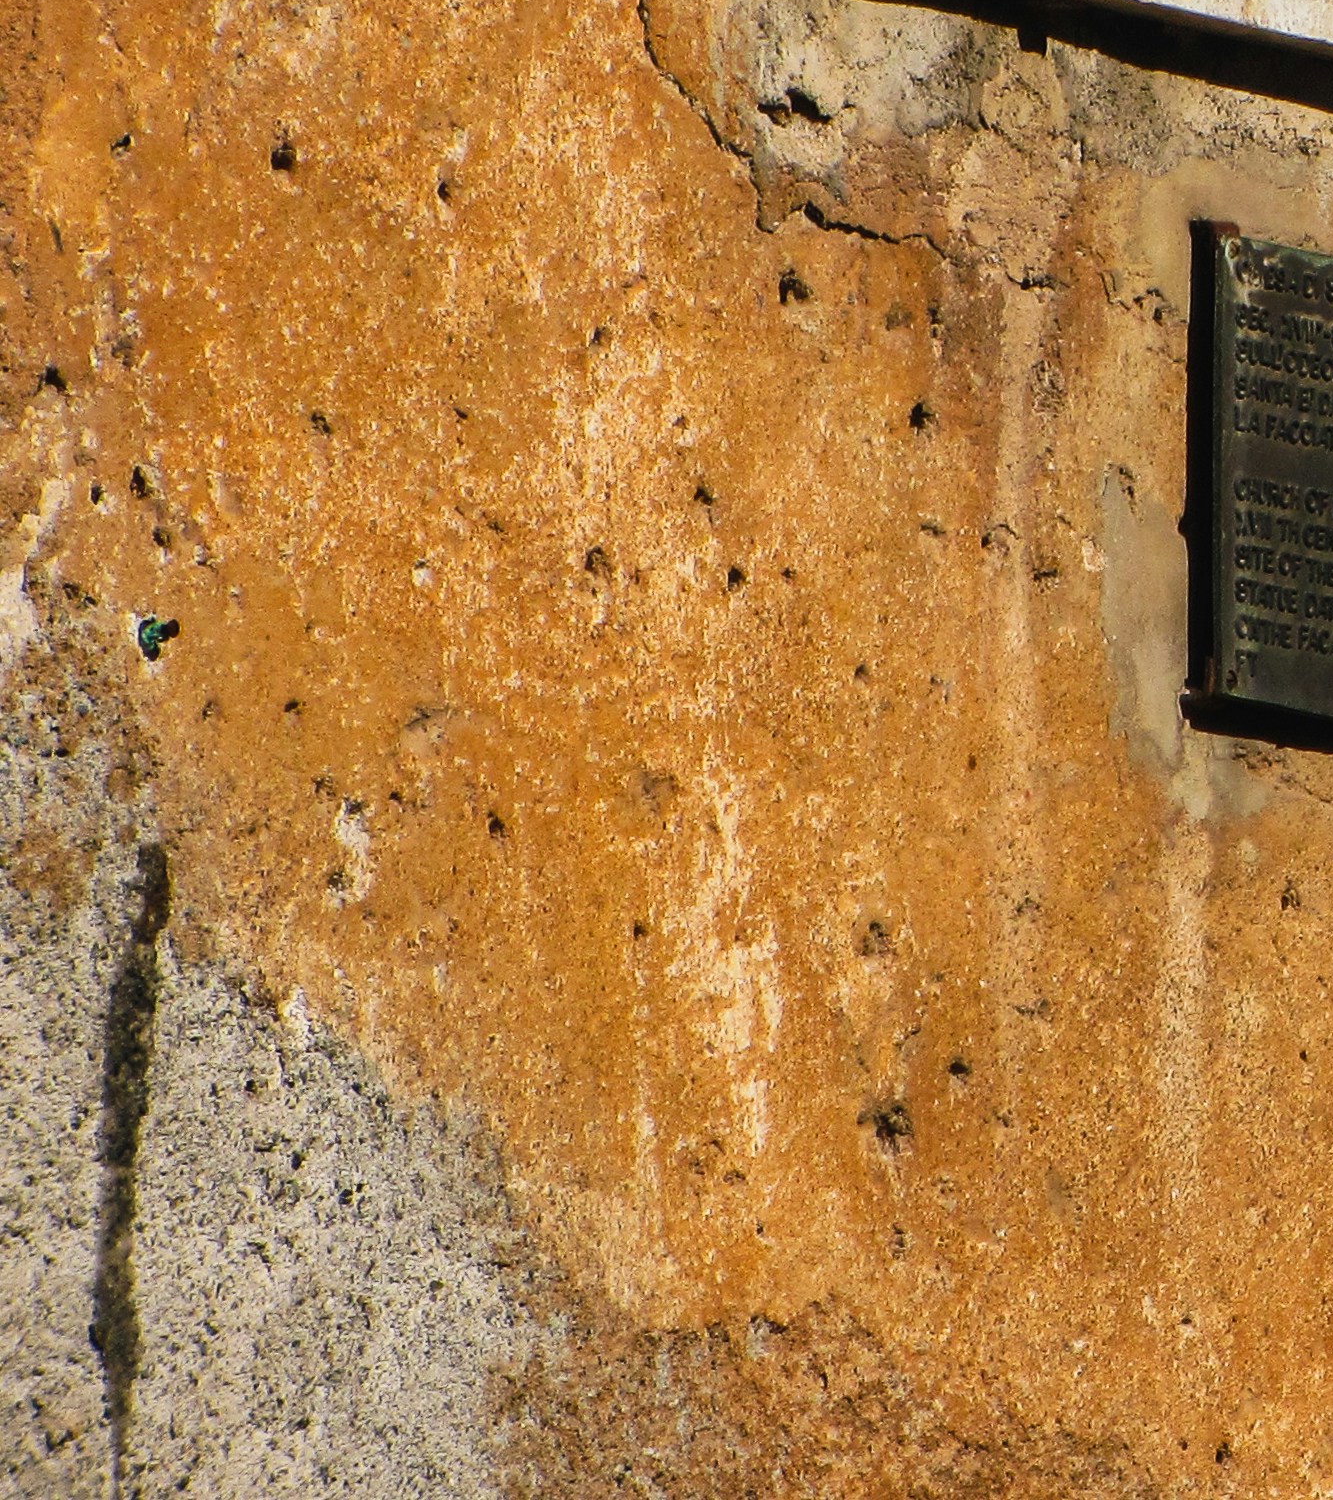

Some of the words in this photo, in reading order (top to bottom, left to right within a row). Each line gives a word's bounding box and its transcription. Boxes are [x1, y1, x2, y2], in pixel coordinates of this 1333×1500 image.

[1235, 373, 1293, 408] SANTA
[1234, 405, 1260, 435] LA
[1234, 478, 1299, 510] CHURCH
[1303, 486, 1330, 516] OF
[1235, 544, 1275, 574] SITE
[1278, 551, 1303, 579] OF
[1235, 575, 1298, 614] STATUE
